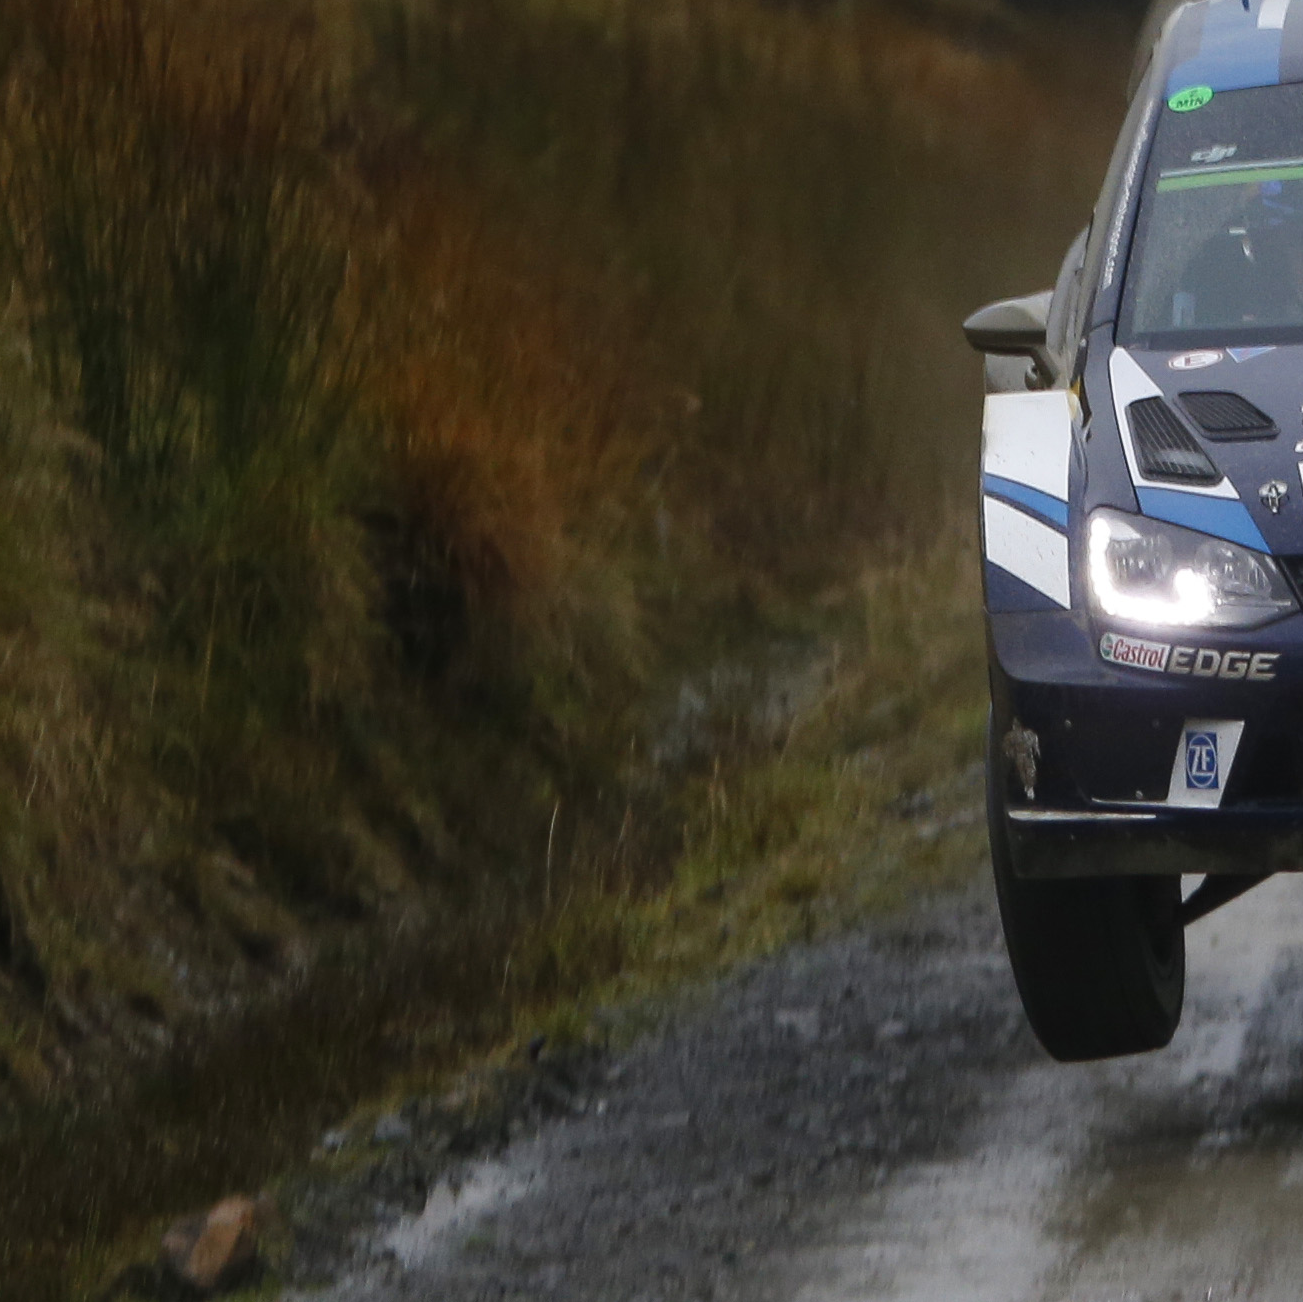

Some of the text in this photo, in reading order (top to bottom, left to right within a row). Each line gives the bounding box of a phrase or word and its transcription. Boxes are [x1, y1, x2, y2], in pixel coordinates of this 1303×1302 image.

[1113, 638, 1283, 681] Castrol EDGE
[1188, 745, 1215, 776] ZF
